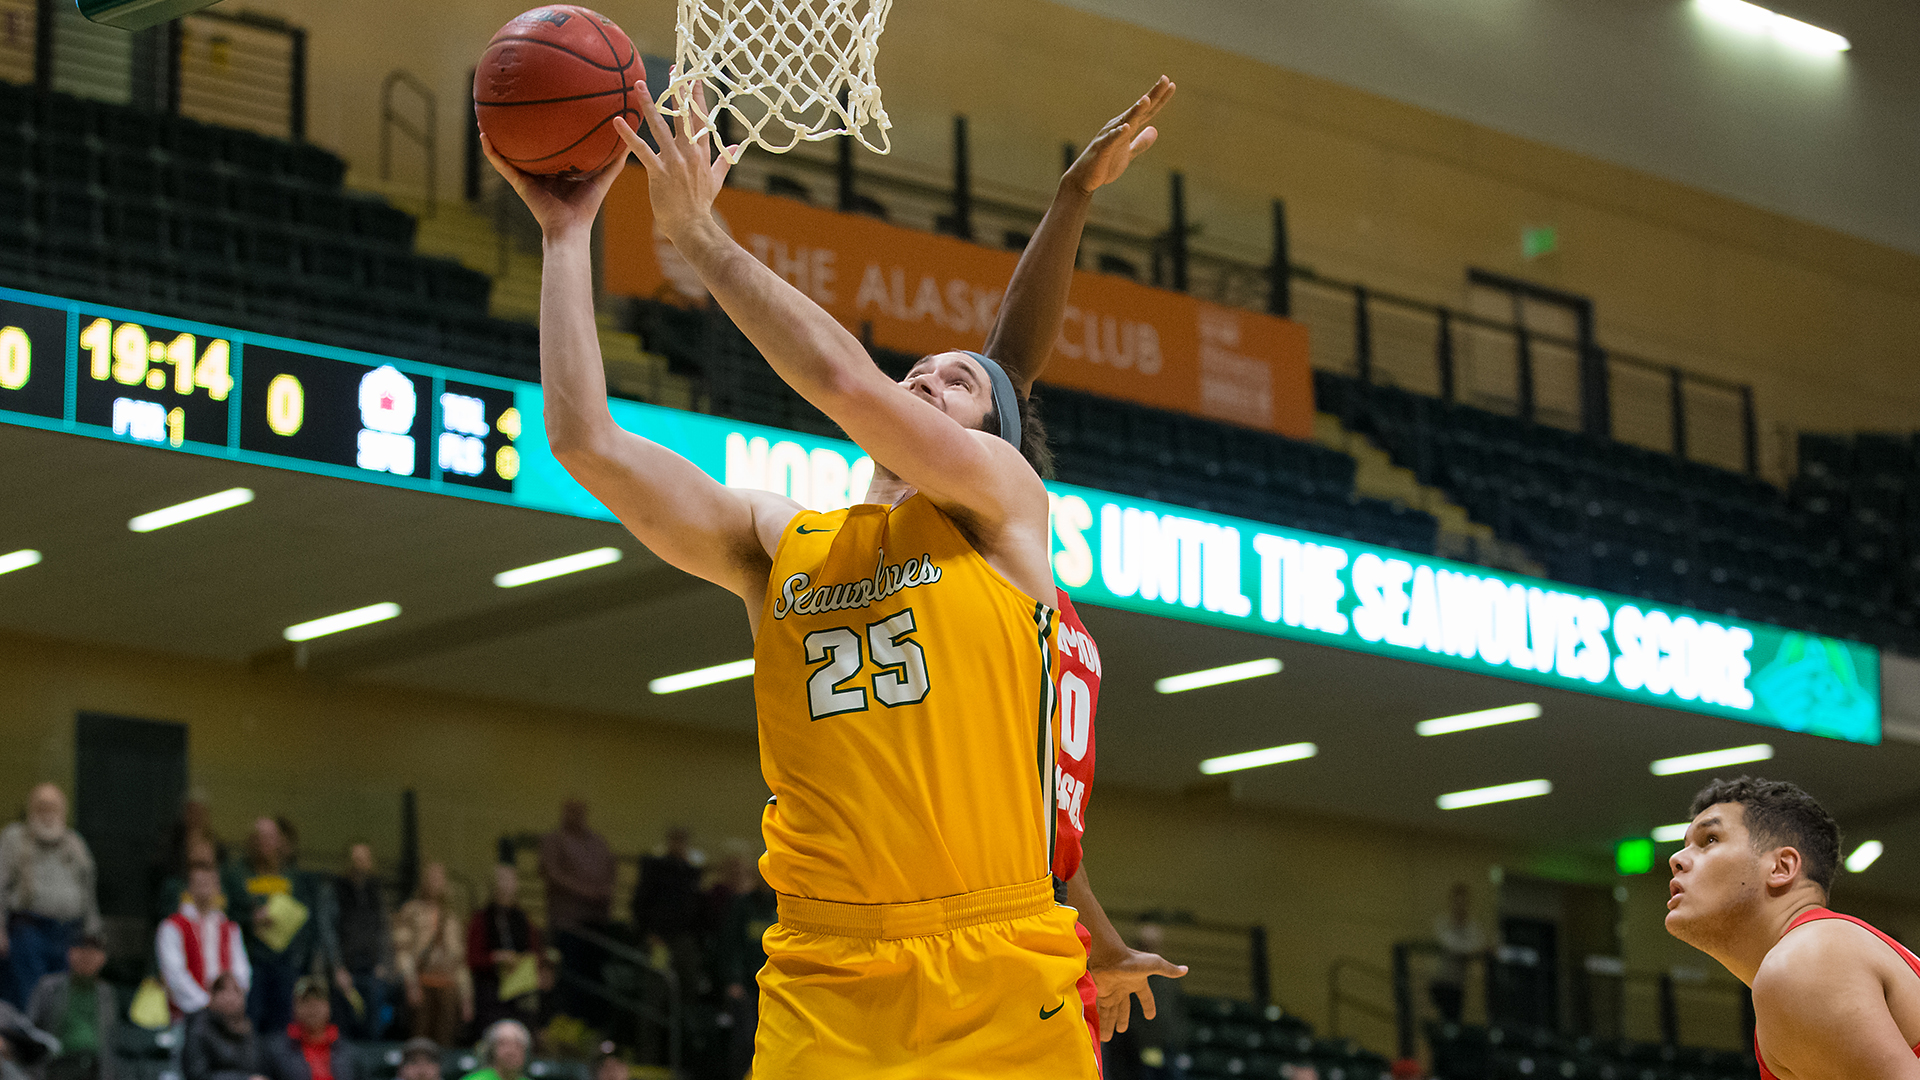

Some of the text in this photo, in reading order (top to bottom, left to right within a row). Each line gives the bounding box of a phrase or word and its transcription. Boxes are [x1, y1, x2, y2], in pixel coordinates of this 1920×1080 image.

[751, 233, 837, 303] THE
[856, 262, 1003, 334] ALASK
[1056, 305, 1162, 375] CLUB
[80, 317, 233, 401] 19:14
[166, 406, 185, 448] 1
[267, 373, 304, 436] 0
[496, 406, 522, 442] 4
[774, 547, 942, 620] Seawolves
[1101, 503, 1251, 616] UNTIL
[1253, 533, 1349, 634] THE
[1352, 553, 1611, 682] SEAWOLVES
[1613, 604, 1753, 709] SCORE
[803, 607, 931, 721] 25
[1058, 622, 1101, 678] MON
[1060, 670, 1091, 762] 0
